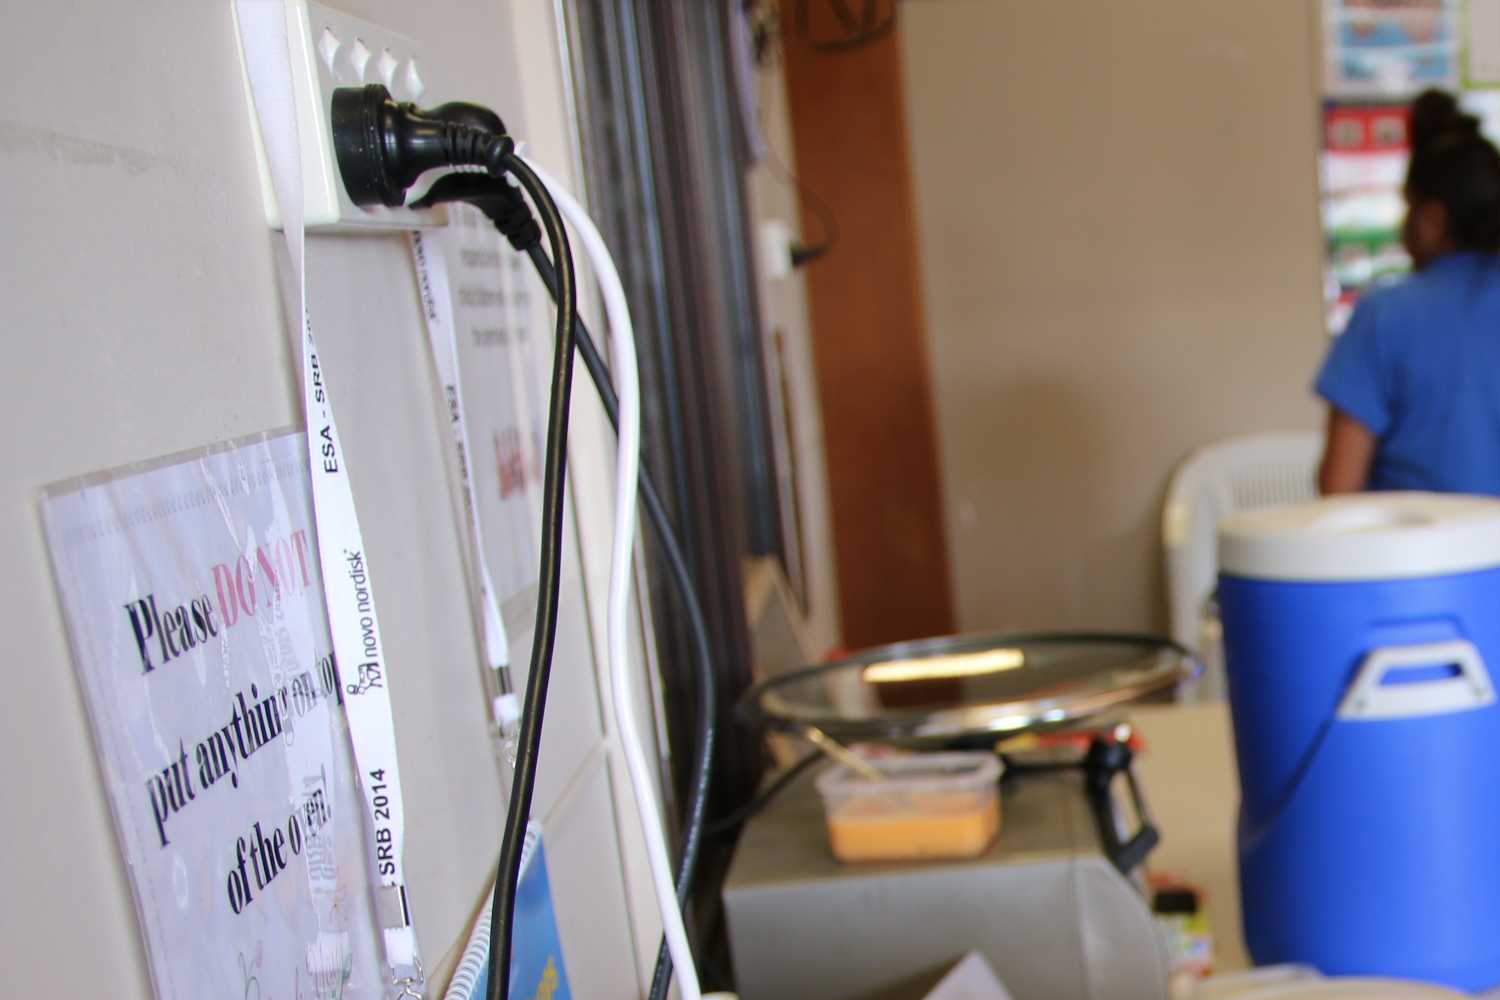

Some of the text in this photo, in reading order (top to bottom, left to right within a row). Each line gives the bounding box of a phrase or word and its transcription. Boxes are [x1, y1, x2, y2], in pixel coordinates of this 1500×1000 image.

[319, 424, 339, 474] ESA
[121, 593, 218, 675] Please
[211, 554, 257, 629] DO
[346, 550, 379, 658] novo nordisk
[147, 736, 196, 848] put
[195, 683, 294, 790] anything
[226, 835, 254, 915] of
[249, 821, 288, 891] the
[368, 768, 397, 876] SRB 2014
